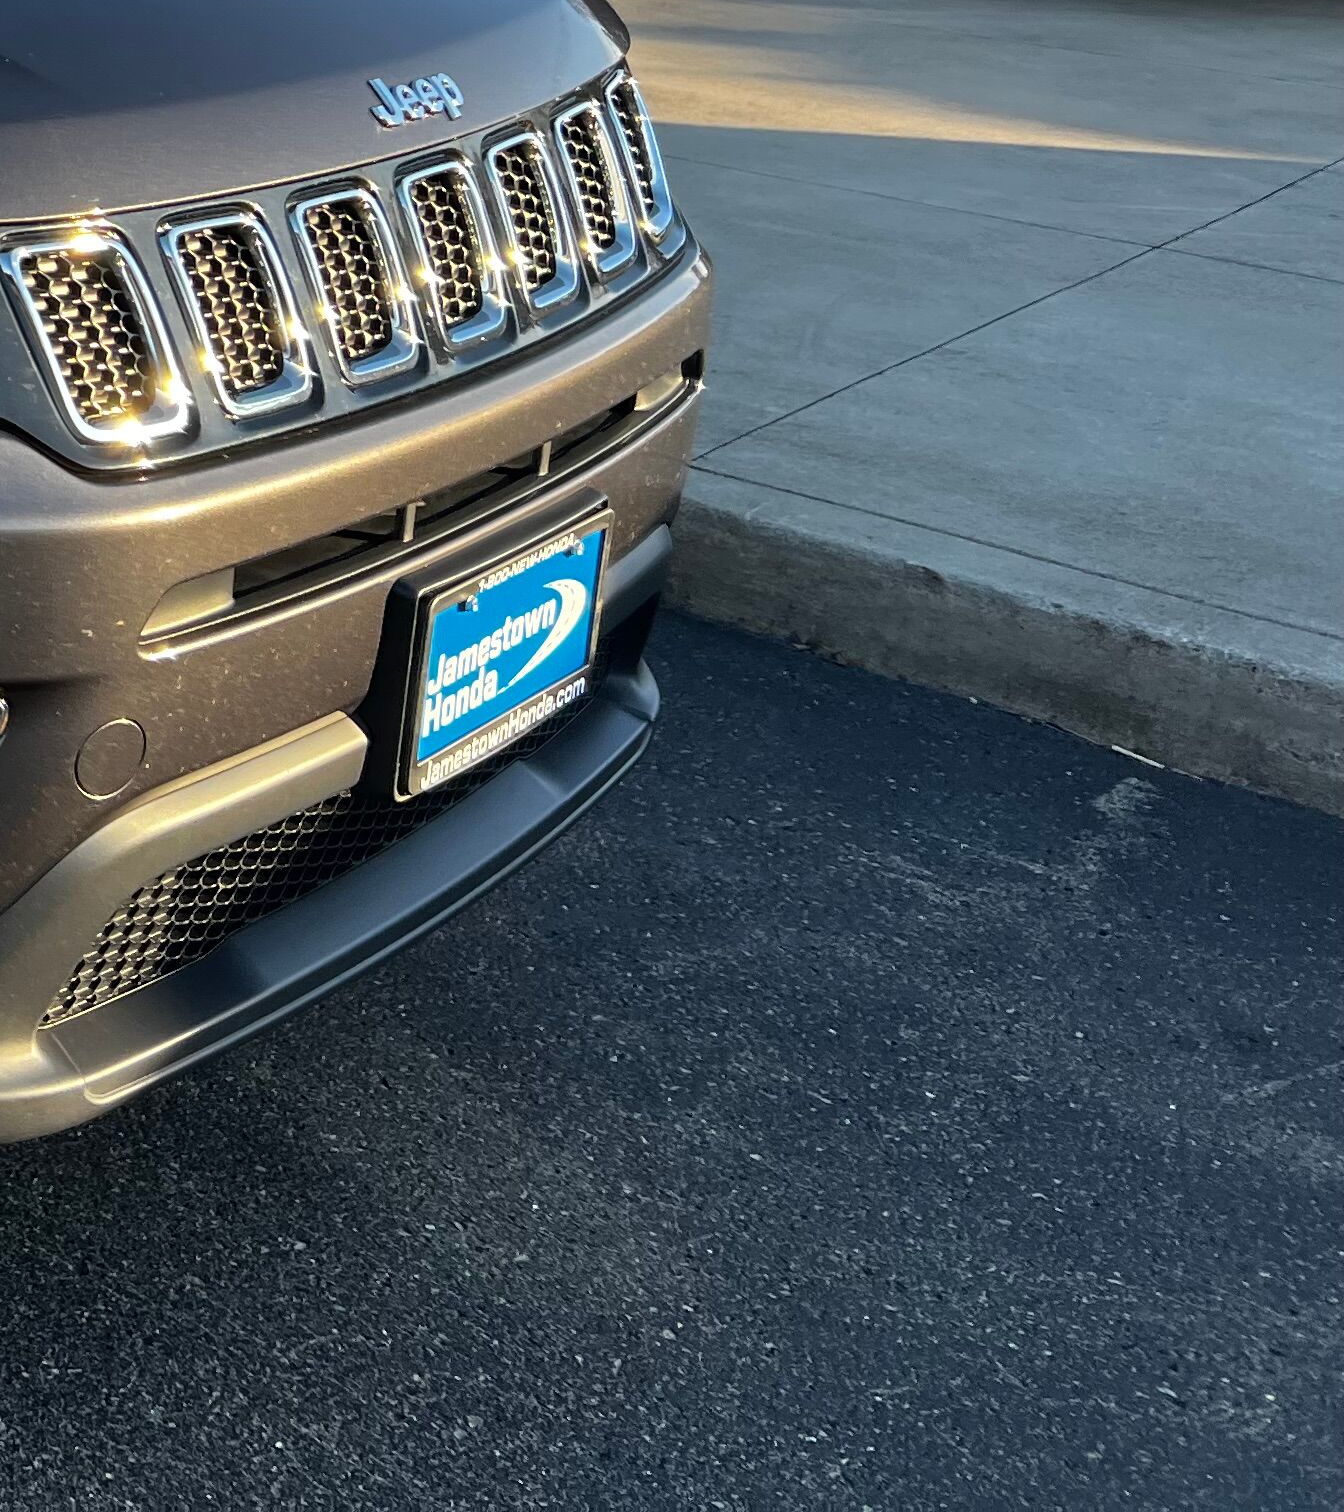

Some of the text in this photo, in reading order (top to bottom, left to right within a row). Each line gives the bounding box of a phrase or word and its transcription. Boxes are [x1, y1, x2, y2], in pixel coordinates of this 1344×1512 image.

[366, 72, 465, 129] Jeep
[427, 597, 557, 693] Jamestown
[420, 675, 586, 790] JamestownHonda.com
[421, 665, 499, 738] Honda
